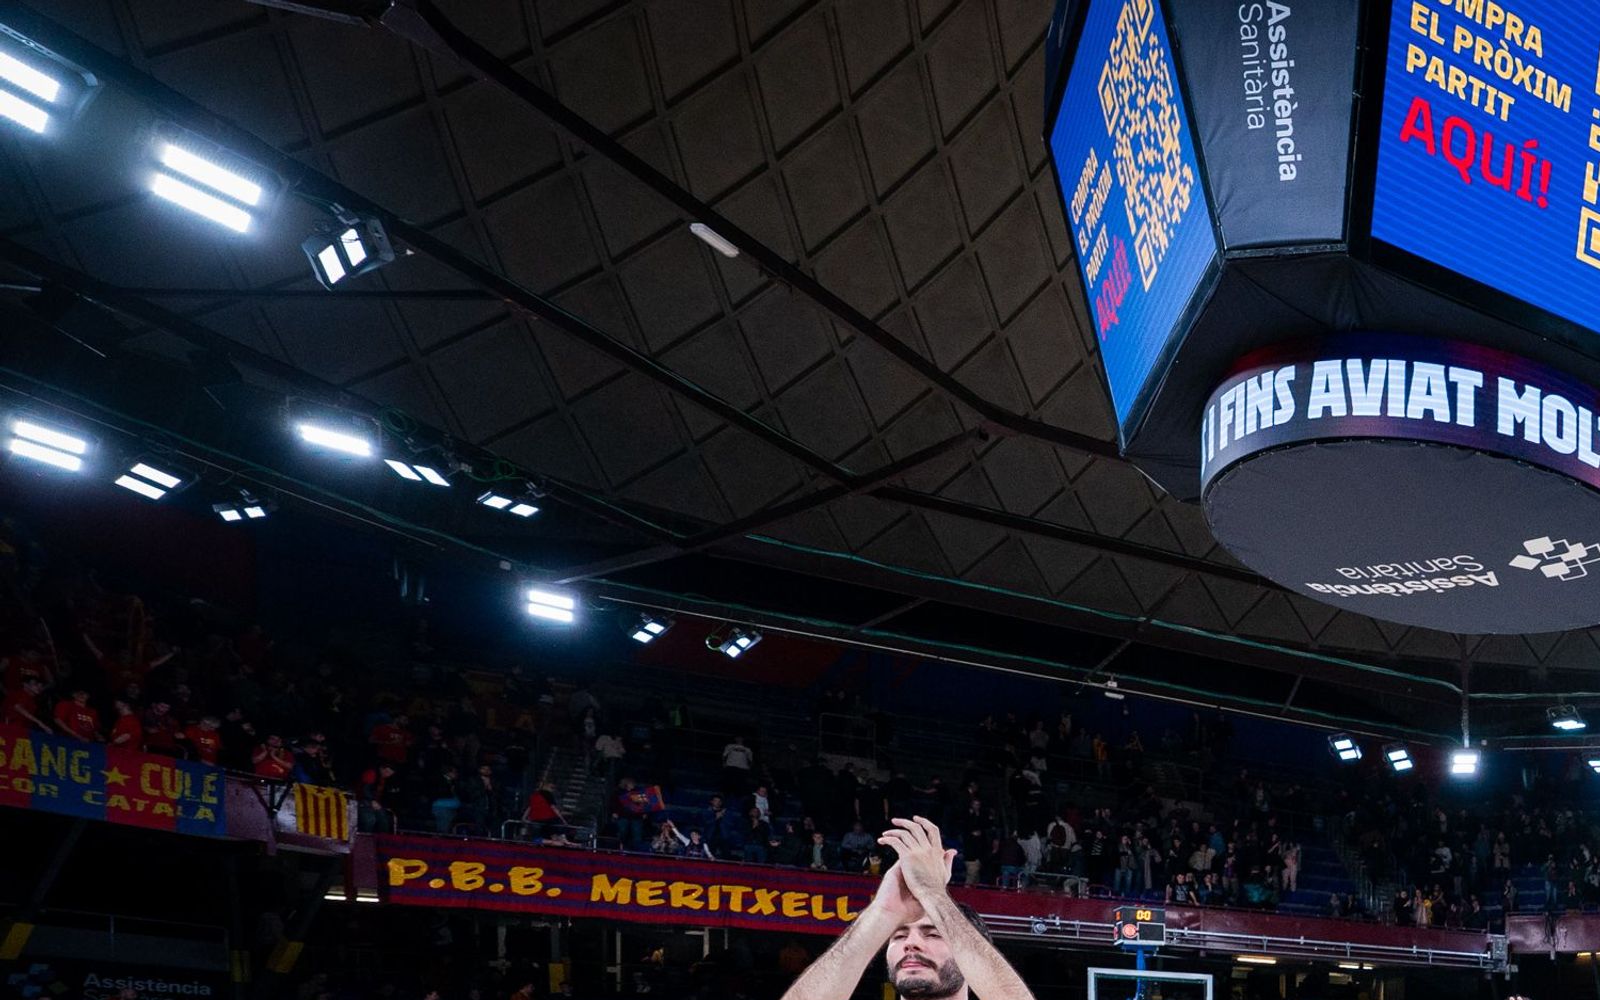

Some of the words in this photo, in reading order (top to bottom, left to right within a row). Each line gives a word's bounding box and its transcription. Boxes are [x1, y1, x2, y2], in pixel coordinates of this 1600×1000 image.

[1238, 3, 1271, 130] Sanitària
[1410, 1, 1445, 45] EL
[1453, 24, 1572, 113] PRÒXIM
[1438, 0, 1543, 58] MPRA
[1266, 0, 1302, 182] Assistència
[1406, 43, 1515, 122] PARTIT
[1400, 96, 1552, 209] AQUÍ!
[1219, 364, 1296, 450] FINS
[1307, 358, 1483, 427] AVIAT
[1305, 571, 1500, 597] Assistència
[1336, 554, 1484, 578] Sanitària
[387, 858, 561, 898] P.B.B.
[590, 873, 859, 922] MERITXELL
[83, 972, 211, 996] Assistència
